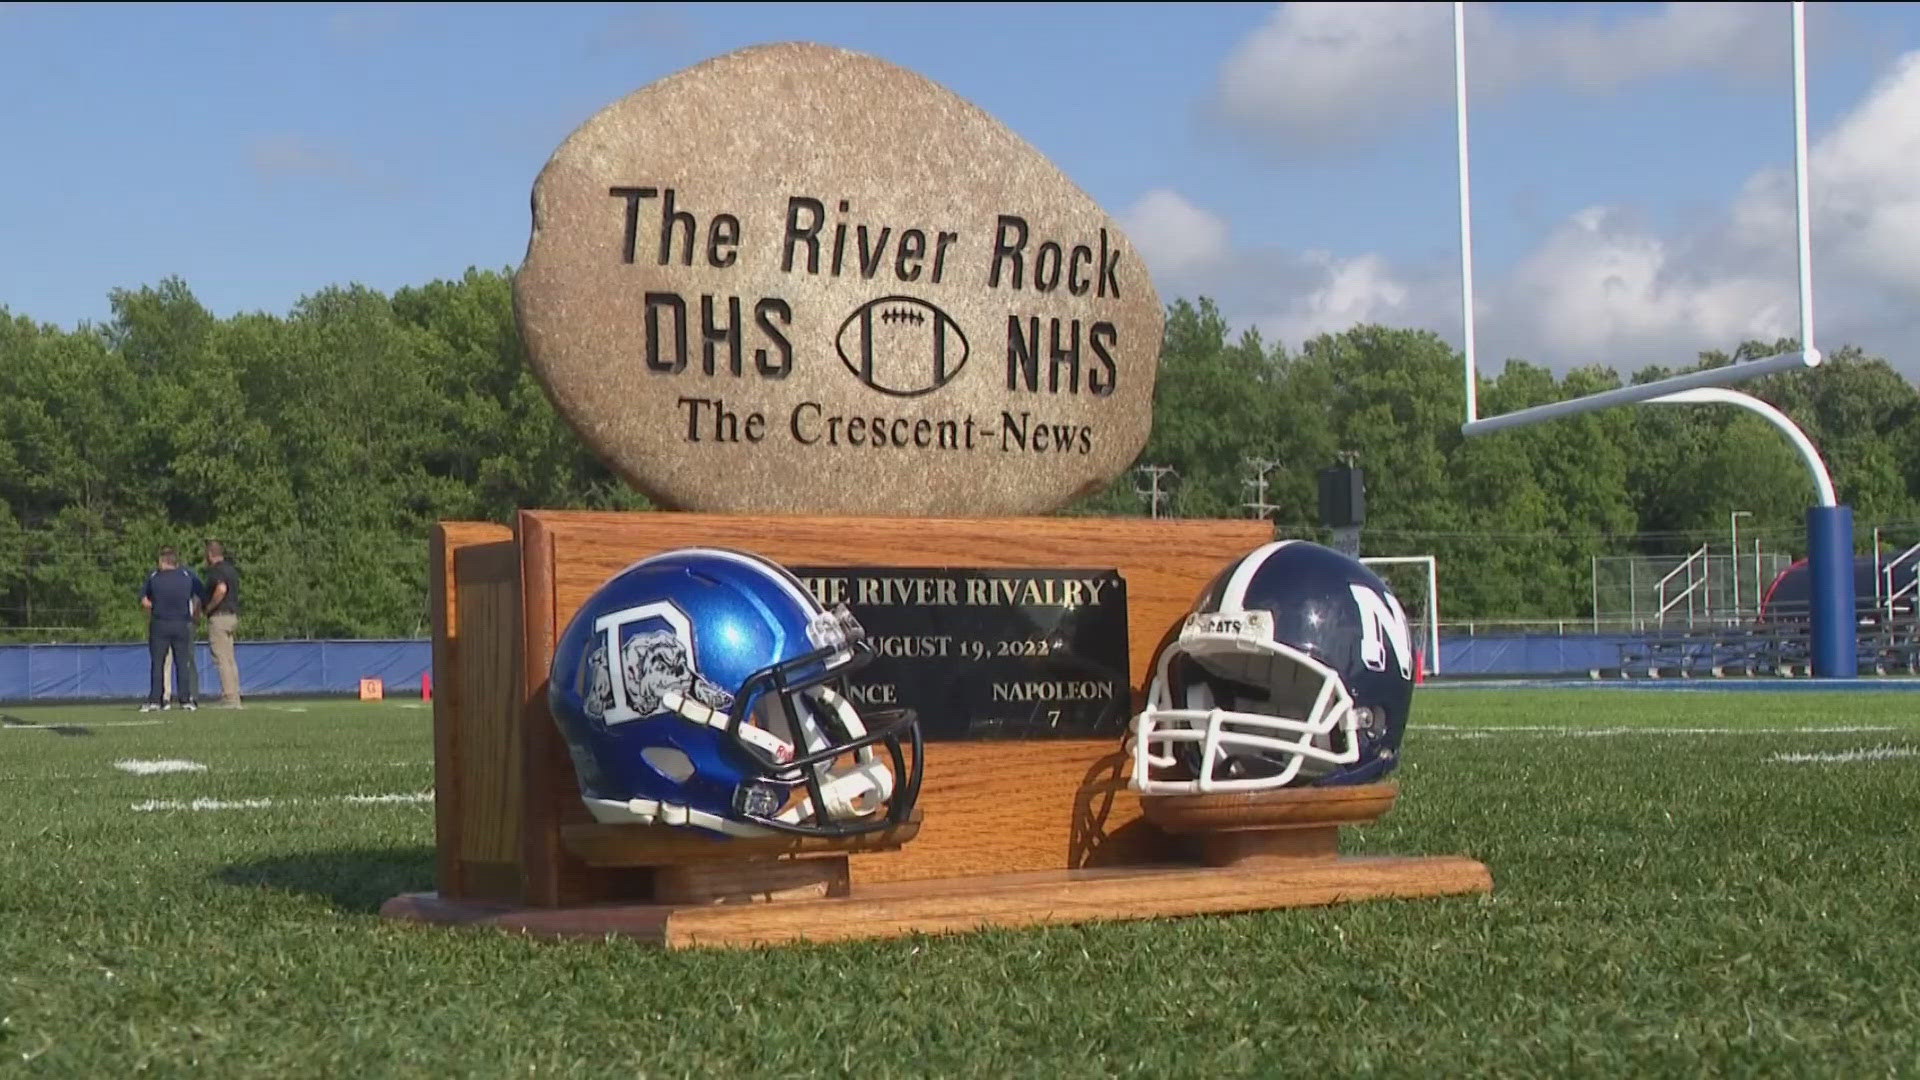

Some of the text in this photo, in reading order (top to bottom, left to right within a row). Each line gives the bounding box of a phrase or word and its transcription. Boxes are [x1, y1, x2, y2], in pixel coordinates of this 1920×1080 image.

[610, 187, 1121, 299] The River Rock
[645, 292, 793, 380] DHS
[1007, 315, 1118, 397] NHS
[679, 398, 1092, 455] The Crescent-News
[802, 576, 1106, 608] HE RIVER RIVALRY
[868, 636, 952, 657] UGUST
[960, 641, 991, 662] 19,
[1349, 583, 1413, 681] N
[992, 681, 1114, 701] NAPOLEON
[1048, 710, 1061, 728] 7
